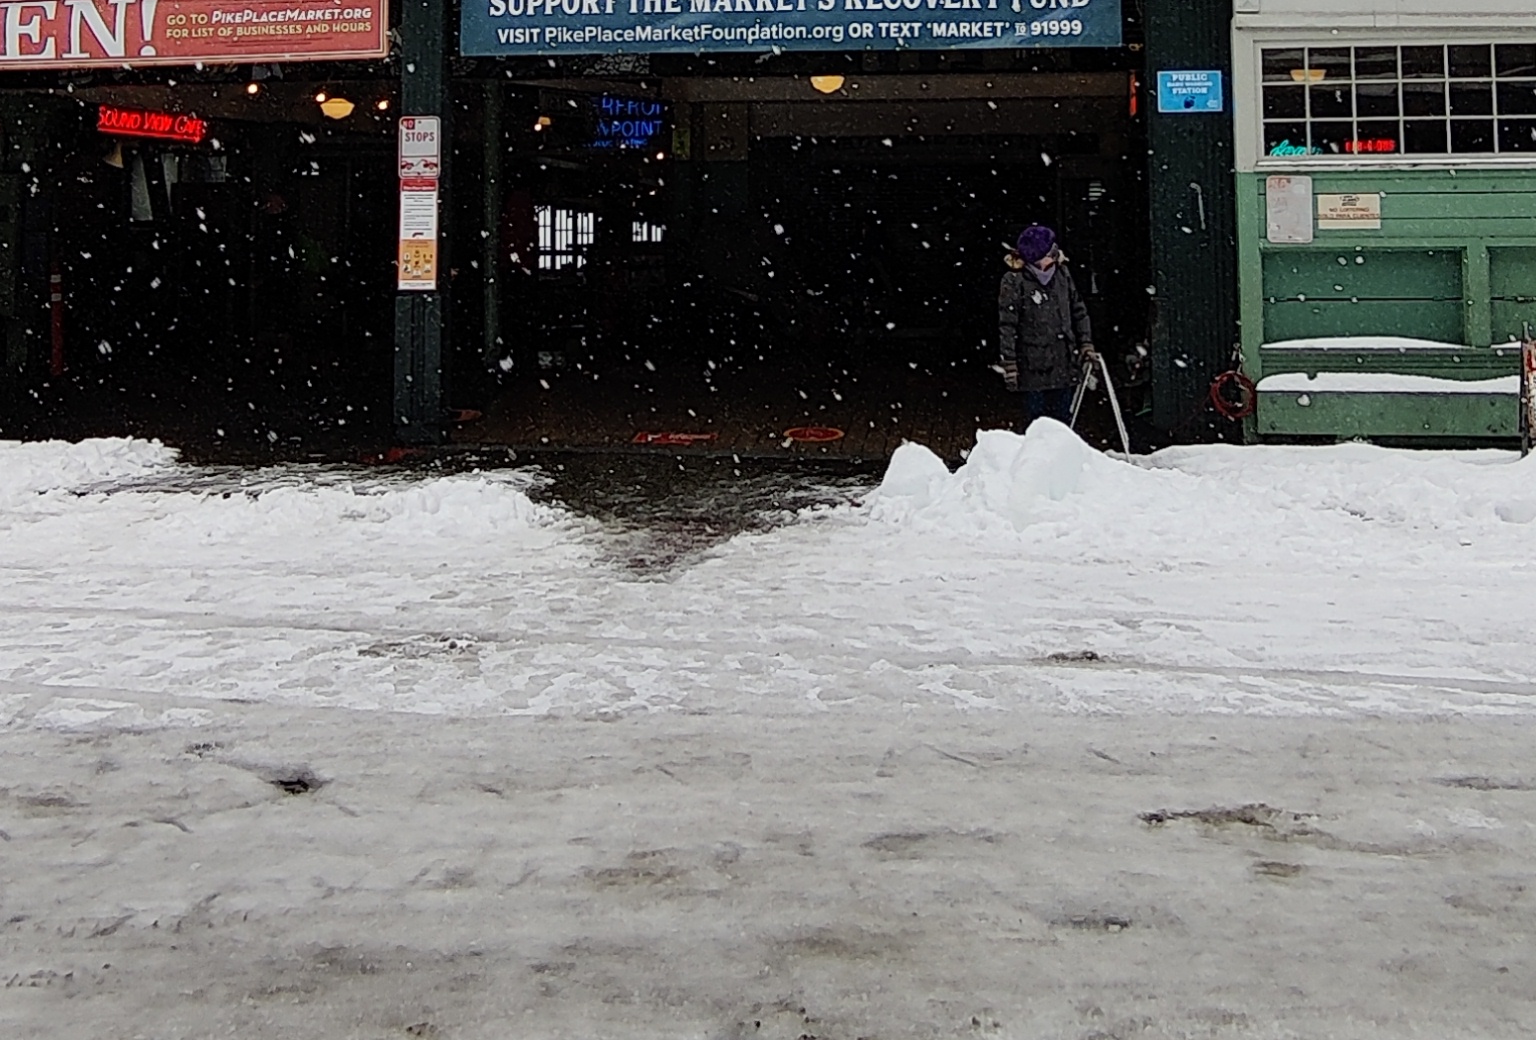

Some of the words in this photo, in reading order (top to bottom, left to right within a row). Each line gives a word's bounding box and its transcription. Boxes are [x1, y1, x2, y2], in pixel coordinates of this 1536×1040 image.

[166, 15, 186, 26] GO
[190, 14, 209, 25] TO
[166, 27, 188, 38] FOR
[191, 27, 214, 37] LIST
[217, 26, 233, 37] OF
[236, 24, 302, 36] BUSINESSES
[306, 23, 330, 34] AND
[332, 22, 372, 33] HOURS
[497, 28, 541, 44] VISIT
[544, 22, 844, 44] PikePlaceMarketFoundation.org
[848, 23, 874, 39] OR
[878, 22, 922, 38] TEXT
[1030, 20, 1083, 37] 91999
[1172, 73, 1208, 81] PUBLIC
[404, 131, 435, 142] STOPS
